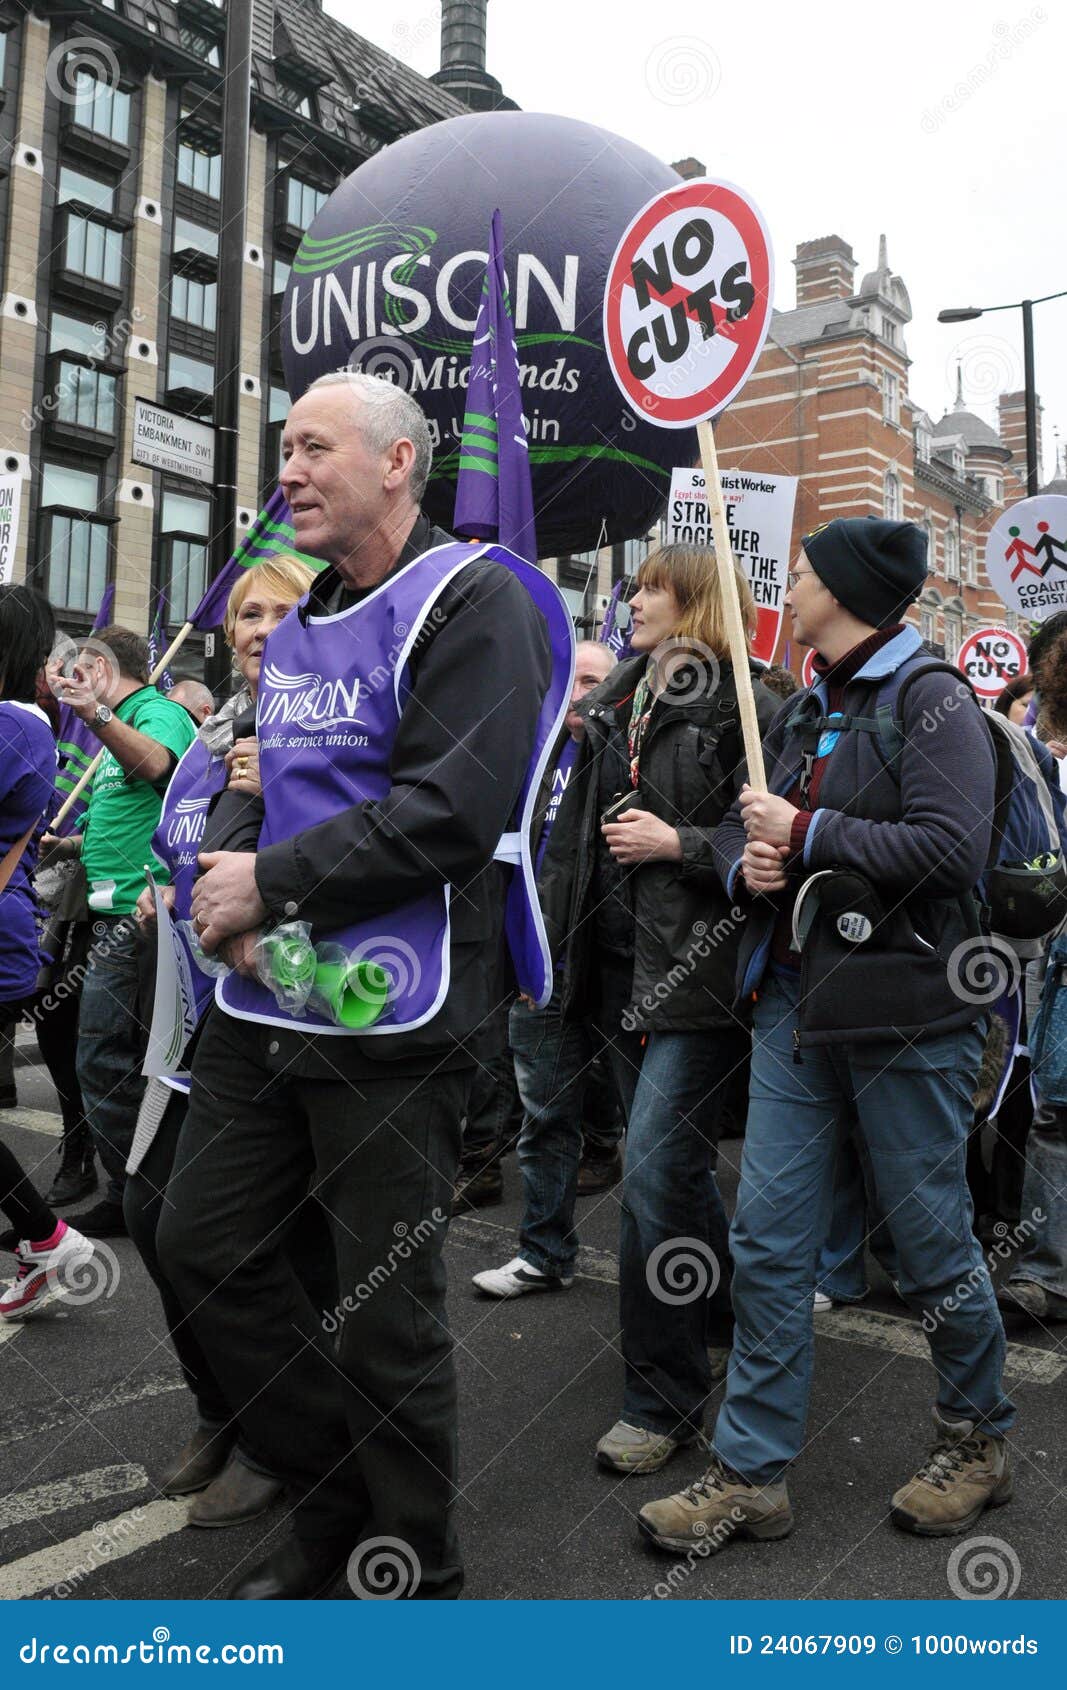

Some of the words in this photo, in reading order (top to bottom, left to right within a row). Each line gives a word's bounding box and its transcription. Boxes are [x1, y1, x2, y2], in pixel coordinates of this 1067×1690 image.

[631, 218, 715, 311] NO
[290, 251, 579, 355] UNISON
[627, 261, 756, 381] CUTS
[140, 408, 174, 430] VICTORIA
[138, 424, 192, 452] EMBANKMENT
[195, 444, 211, 460] SW1
[136, 449, 149, 460] CITY
[152, 453, 160, 463] OF
[161, 456, 202, 477] WESTMINSTER
[674, 489, 692, 500] Egypt
[691, 475, 740, 489] Solist
[741, 477, 777, 494] Worker
[673, 500, 736, 526] STRIE
[672, 525, 759, 553] TOGEHER
[750, 556, 778, 581] THE
[1017, 580, 1067, 597] COALIT
[1021, 593, 1067, 609] RESIST
[975, 642, 1010, 657] NO
[965, 661, 1019, 678] CUTS
[257, 678, 360, 727] UNISON
[287, 731, 323, 748] service
[325, 730, 369, 747] union
